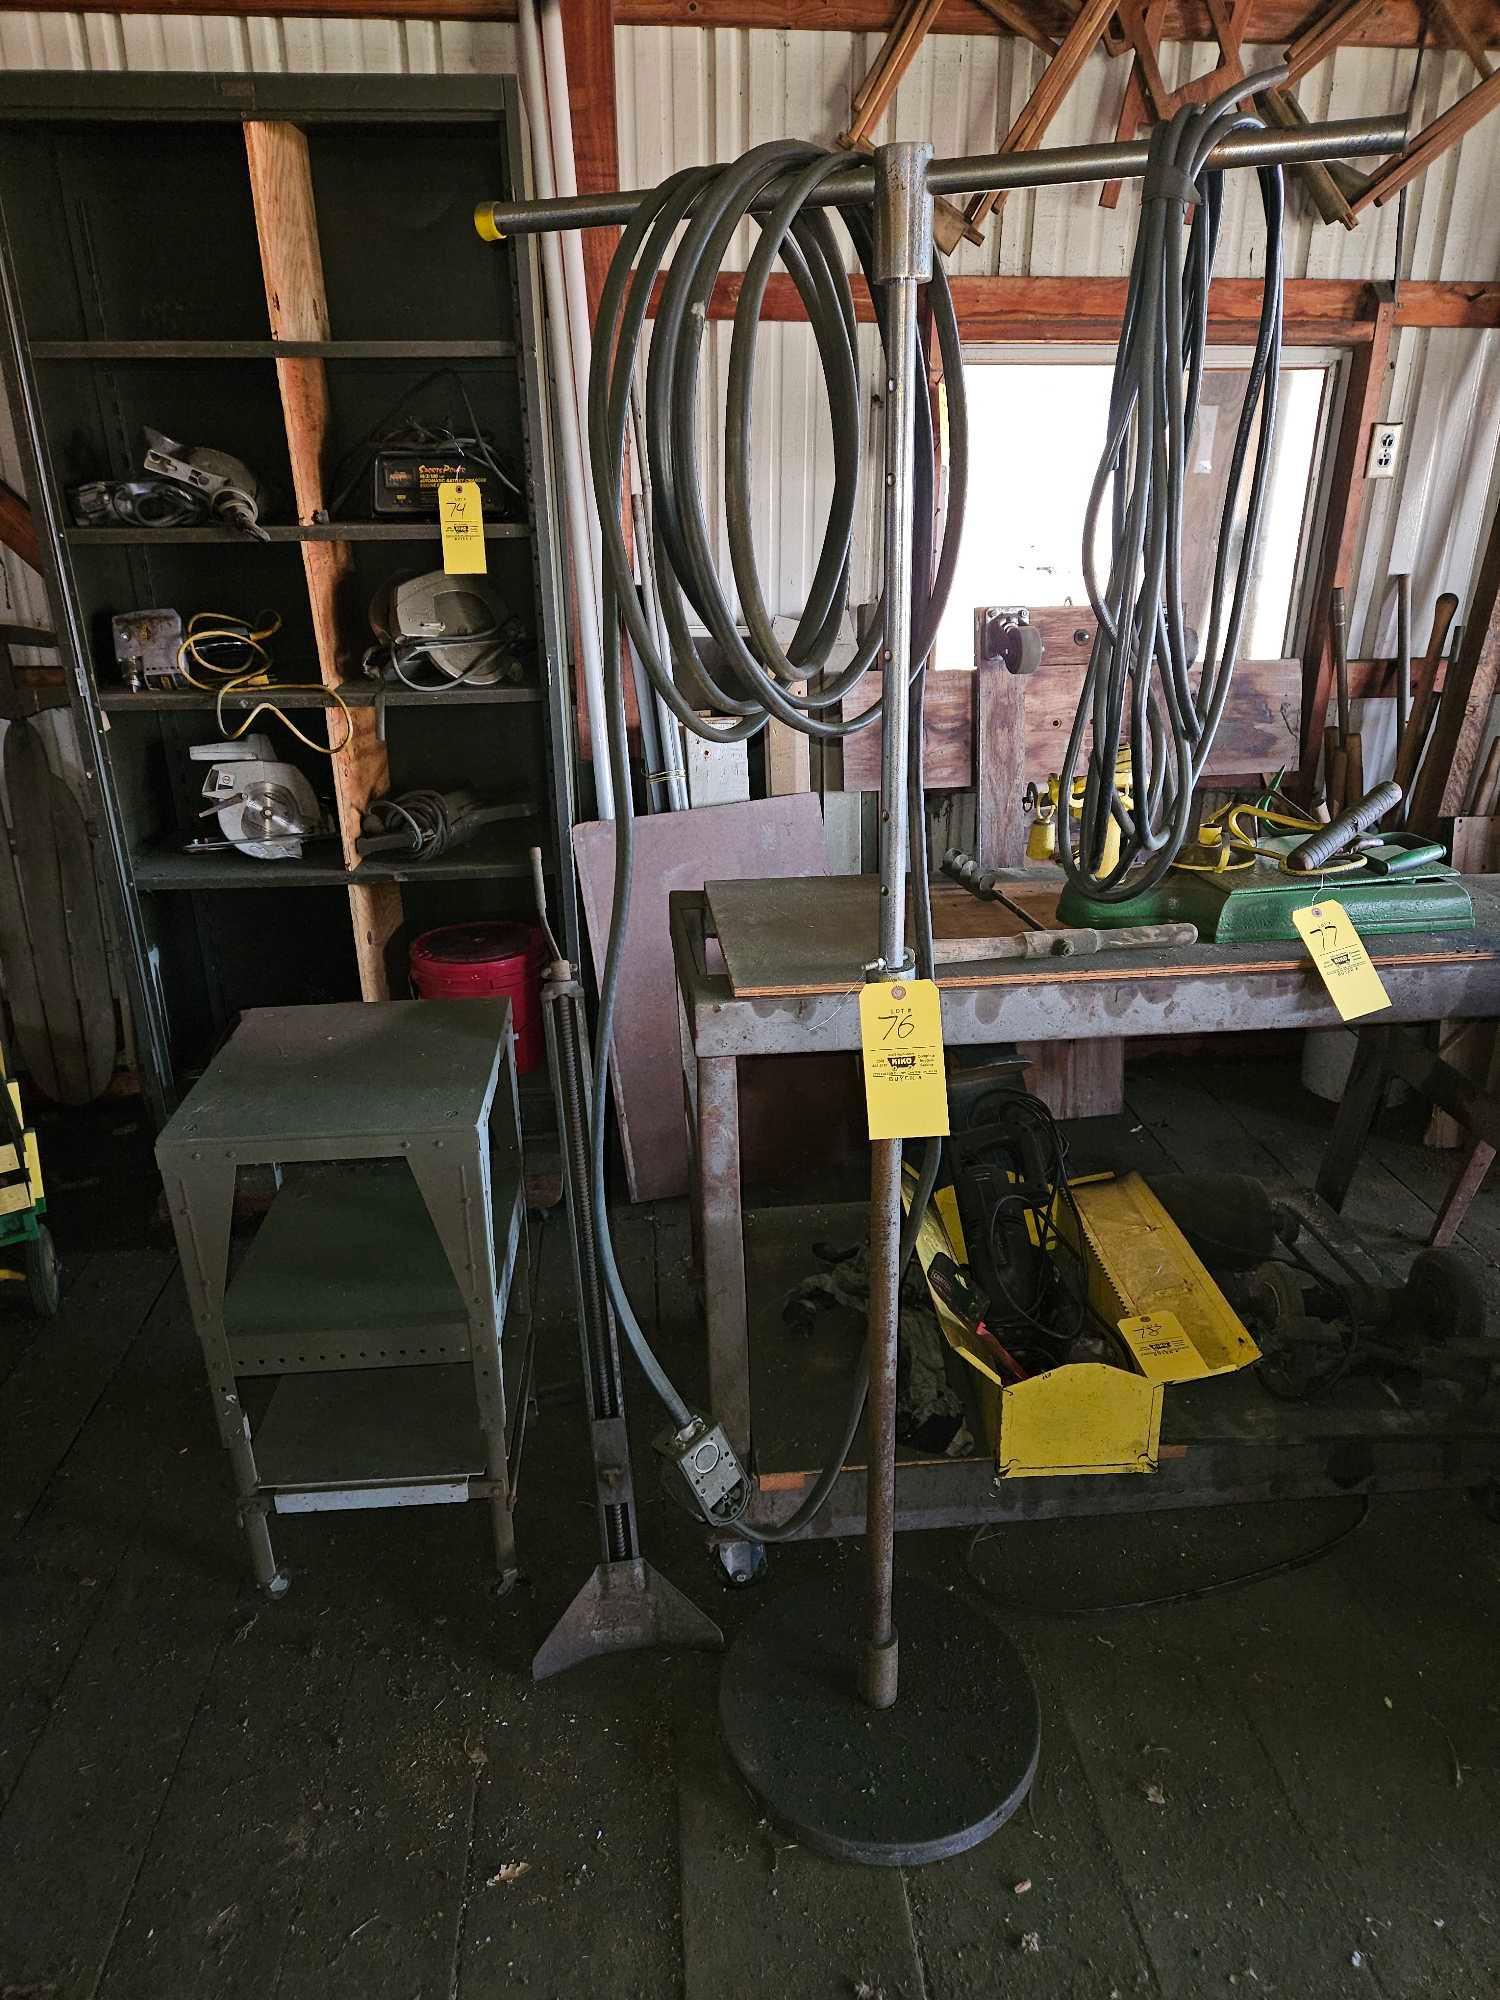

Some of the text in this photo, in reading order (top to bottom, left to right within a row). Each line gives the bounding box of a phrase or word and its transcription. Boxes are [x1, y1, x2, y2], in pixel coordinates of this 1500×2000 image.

[446, 502, 466, 518] 74
[1310, 926, 1337, 949] 77
[878, 1014, 914, 1040] 76
[891, 1057, 912, 1066] KIKO
[1132, 1325, 1162, 1339] 78
